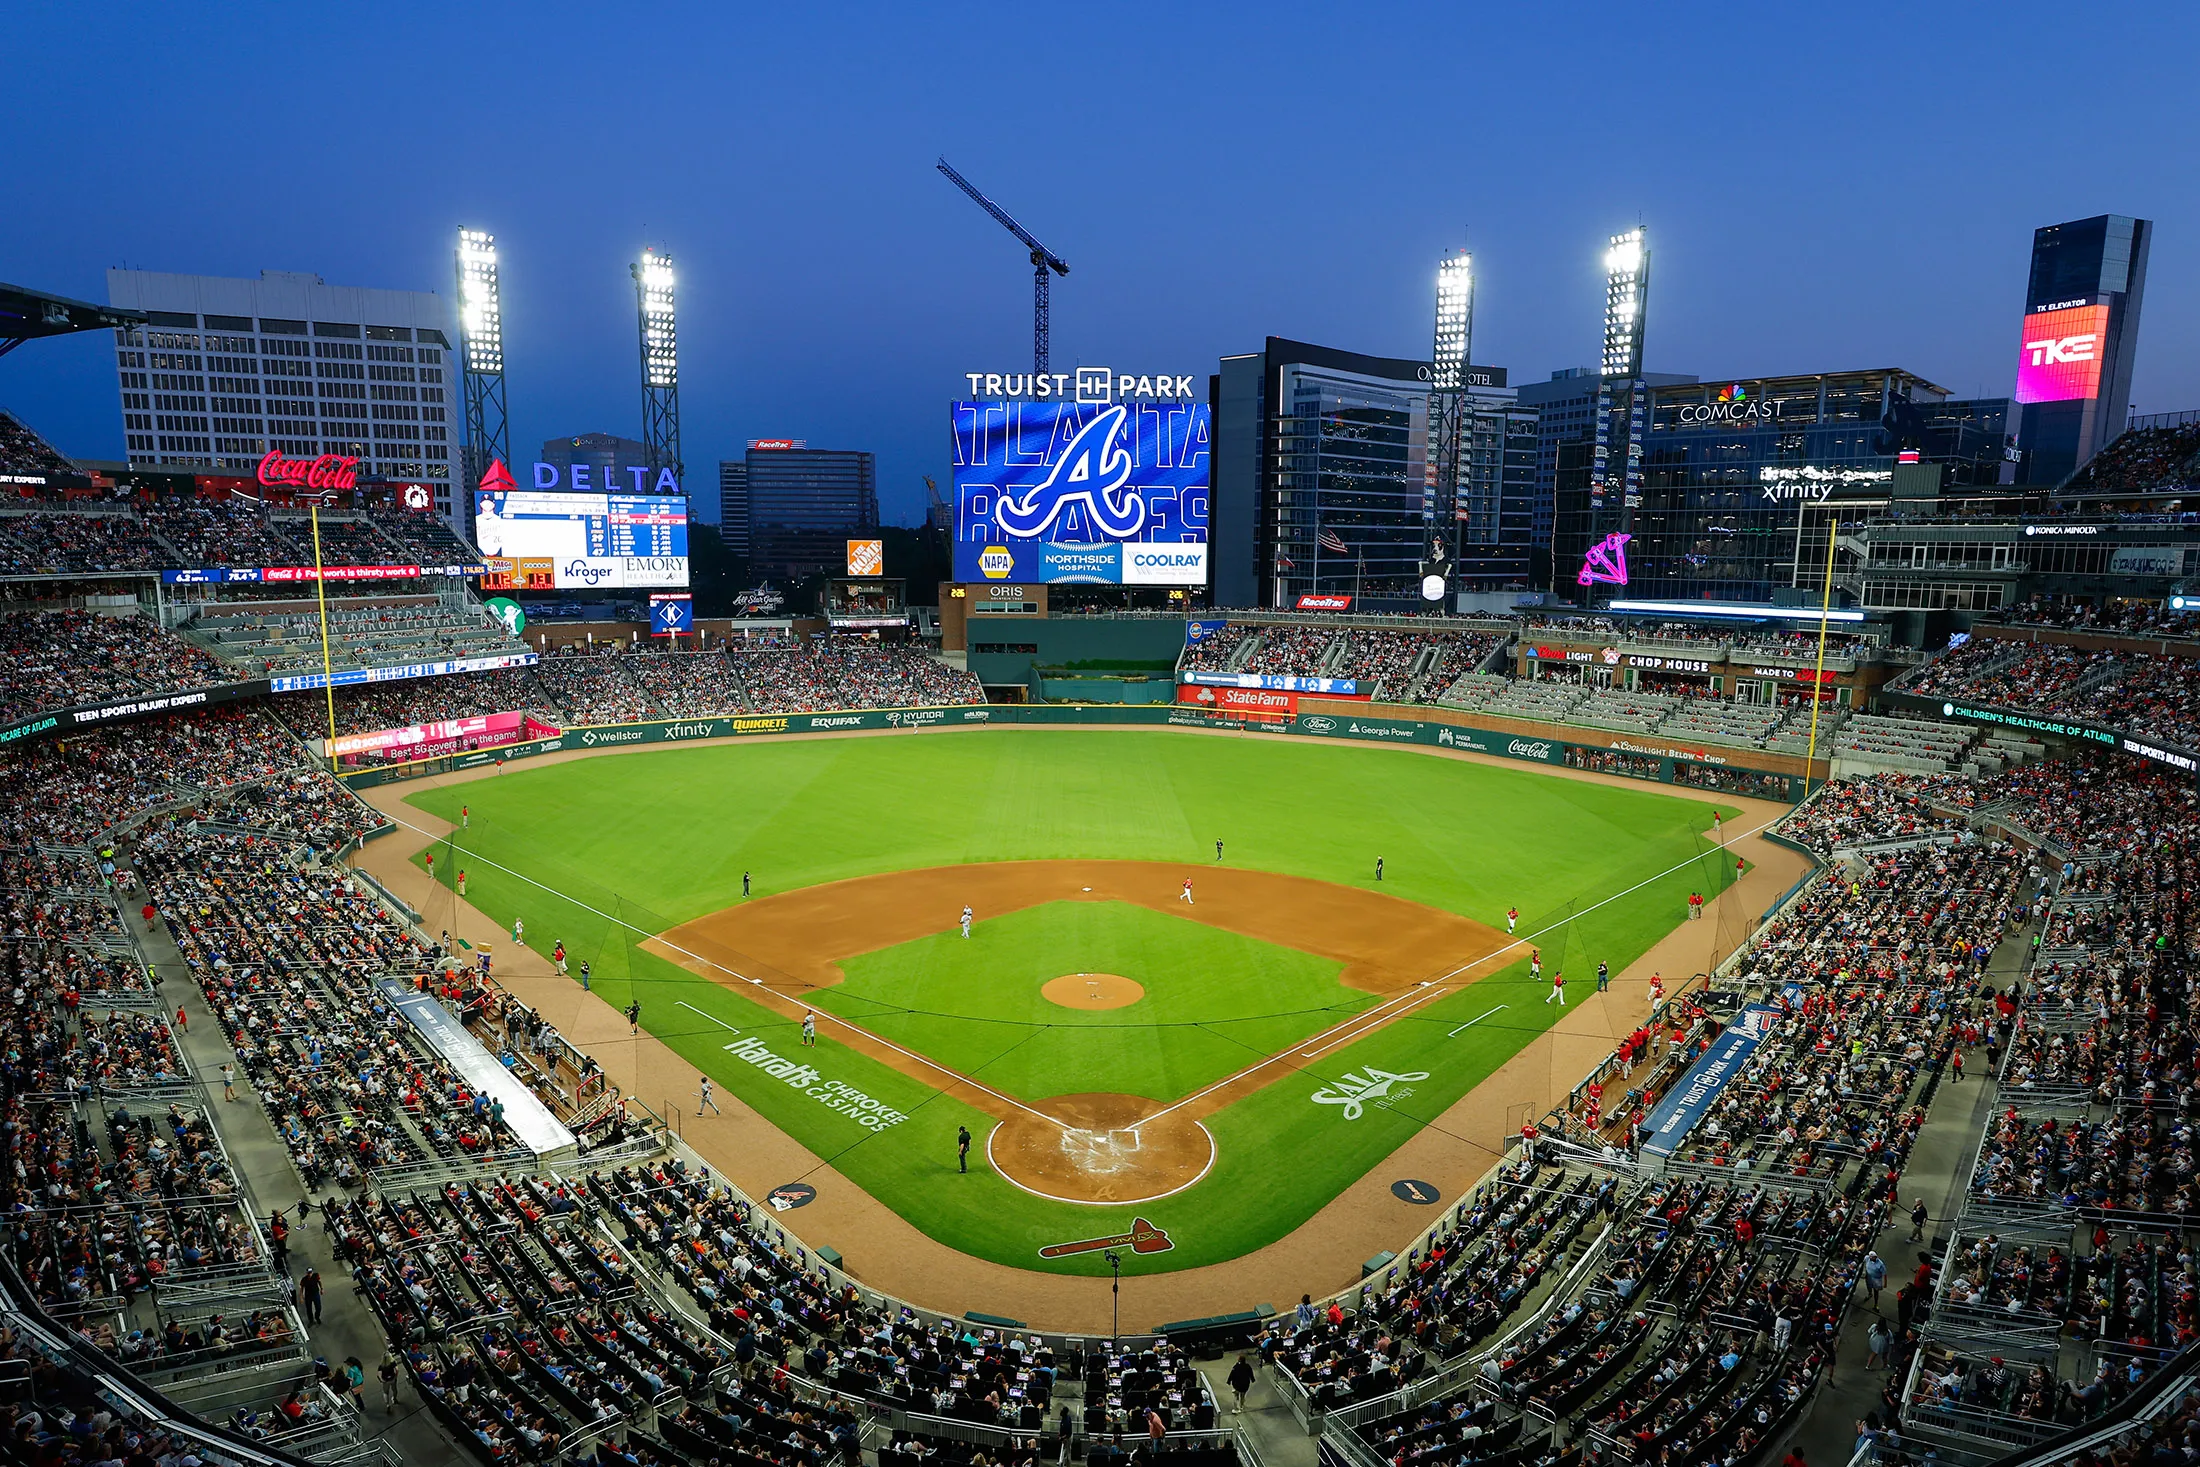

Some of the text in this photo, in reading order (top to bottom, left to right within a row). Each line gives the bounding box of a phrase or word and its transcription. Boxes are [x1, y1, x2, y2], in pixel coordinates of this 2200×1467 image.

[2037, 299, 2086, 313] TK ELEVATOR
[2026, 334, 2097, 367] TKE
[966, 373, 1195, 399] TRUIST PARK
[1680, 400, 1785, 422] COMCAST
[758, 441, 789, 449] RaceTrac
[258, 449, 361, 490] Coca-Cola
[533, 461, 680, 493] DELTA
[14, 475, 47, 485] EXPERTS
[1762, 481, 1834, 504] xfinity
[2035, 527, 2098, 535] KONICA MINOLTA
[627, 557, 685, 572] EMORY
[848, 540, 882, 574] HOME
[983, 555, 1009, 570] NAPA
[1046, 554, 1116, 565] NORTHSIDE
[1134, 554, 1203, 567] COOLRAY
[325, 569, 346, 579] work
[348, 569, 356, 578] is
[357, 568, 389, 580] thirsty
[390, 566, 408, 577] work
[565, 558, 613, 586] Kroger
[990, 586, 1024, 598] ORIS
[1302, 598, 1345, 609] RaceTrac
[666, 606, 677, 622] K
[1537, 646, 1594, 662] Coors LIGHT
[1628, 656, 1709, 673] CHOP HOUSE
[1754, 667, 1795, 678] MADE TO
[73, 692, 207, 723] TEEN SPORTS INJURY EXPERTS
[733, 718, 789, 730] QUIKRETE
[811, 715, 865, 729] EQUIFAX
[903, 711, 944, 721] HYUNDAI
[22, 717, 58, 736] OF ATLANTA
[665, 722, 714, 740] xfinity
[1308, 719, 1331, 731] Ford
[1362, 725, 1415, 738] Georgia Power
[1955, 706, 2115, 745] CHILDREN'S HEALTHCARE OF ATLANTA
[599, 730, 643, 743] Wellstar
[1456, 733, 1471, 742] KAISER
[390, 747, 412, 759] Best
[413, 744, 427, 755] 5G
[469, 737, 477, 746] in
[478, 734, 492, 744] the
[493, 731, 517, 743] game
[1507, 739, 1551, 761] Coca-Cola
[1619, 740, 1727, 765] Coors LIGHT BELOW CHOP
[2124, 739, 2192, 770] TEEN SPORTS INJURY
[1679, 1083, 1709, 1107] TRUIST
[1706, 1060, 1730, 1077] PARK
[1310, 1065, 1430, 1121] SAIA
[805, 1086, 890, 1133] CASINOS
[823, 1080, 910, 1125] CHEROKEE
